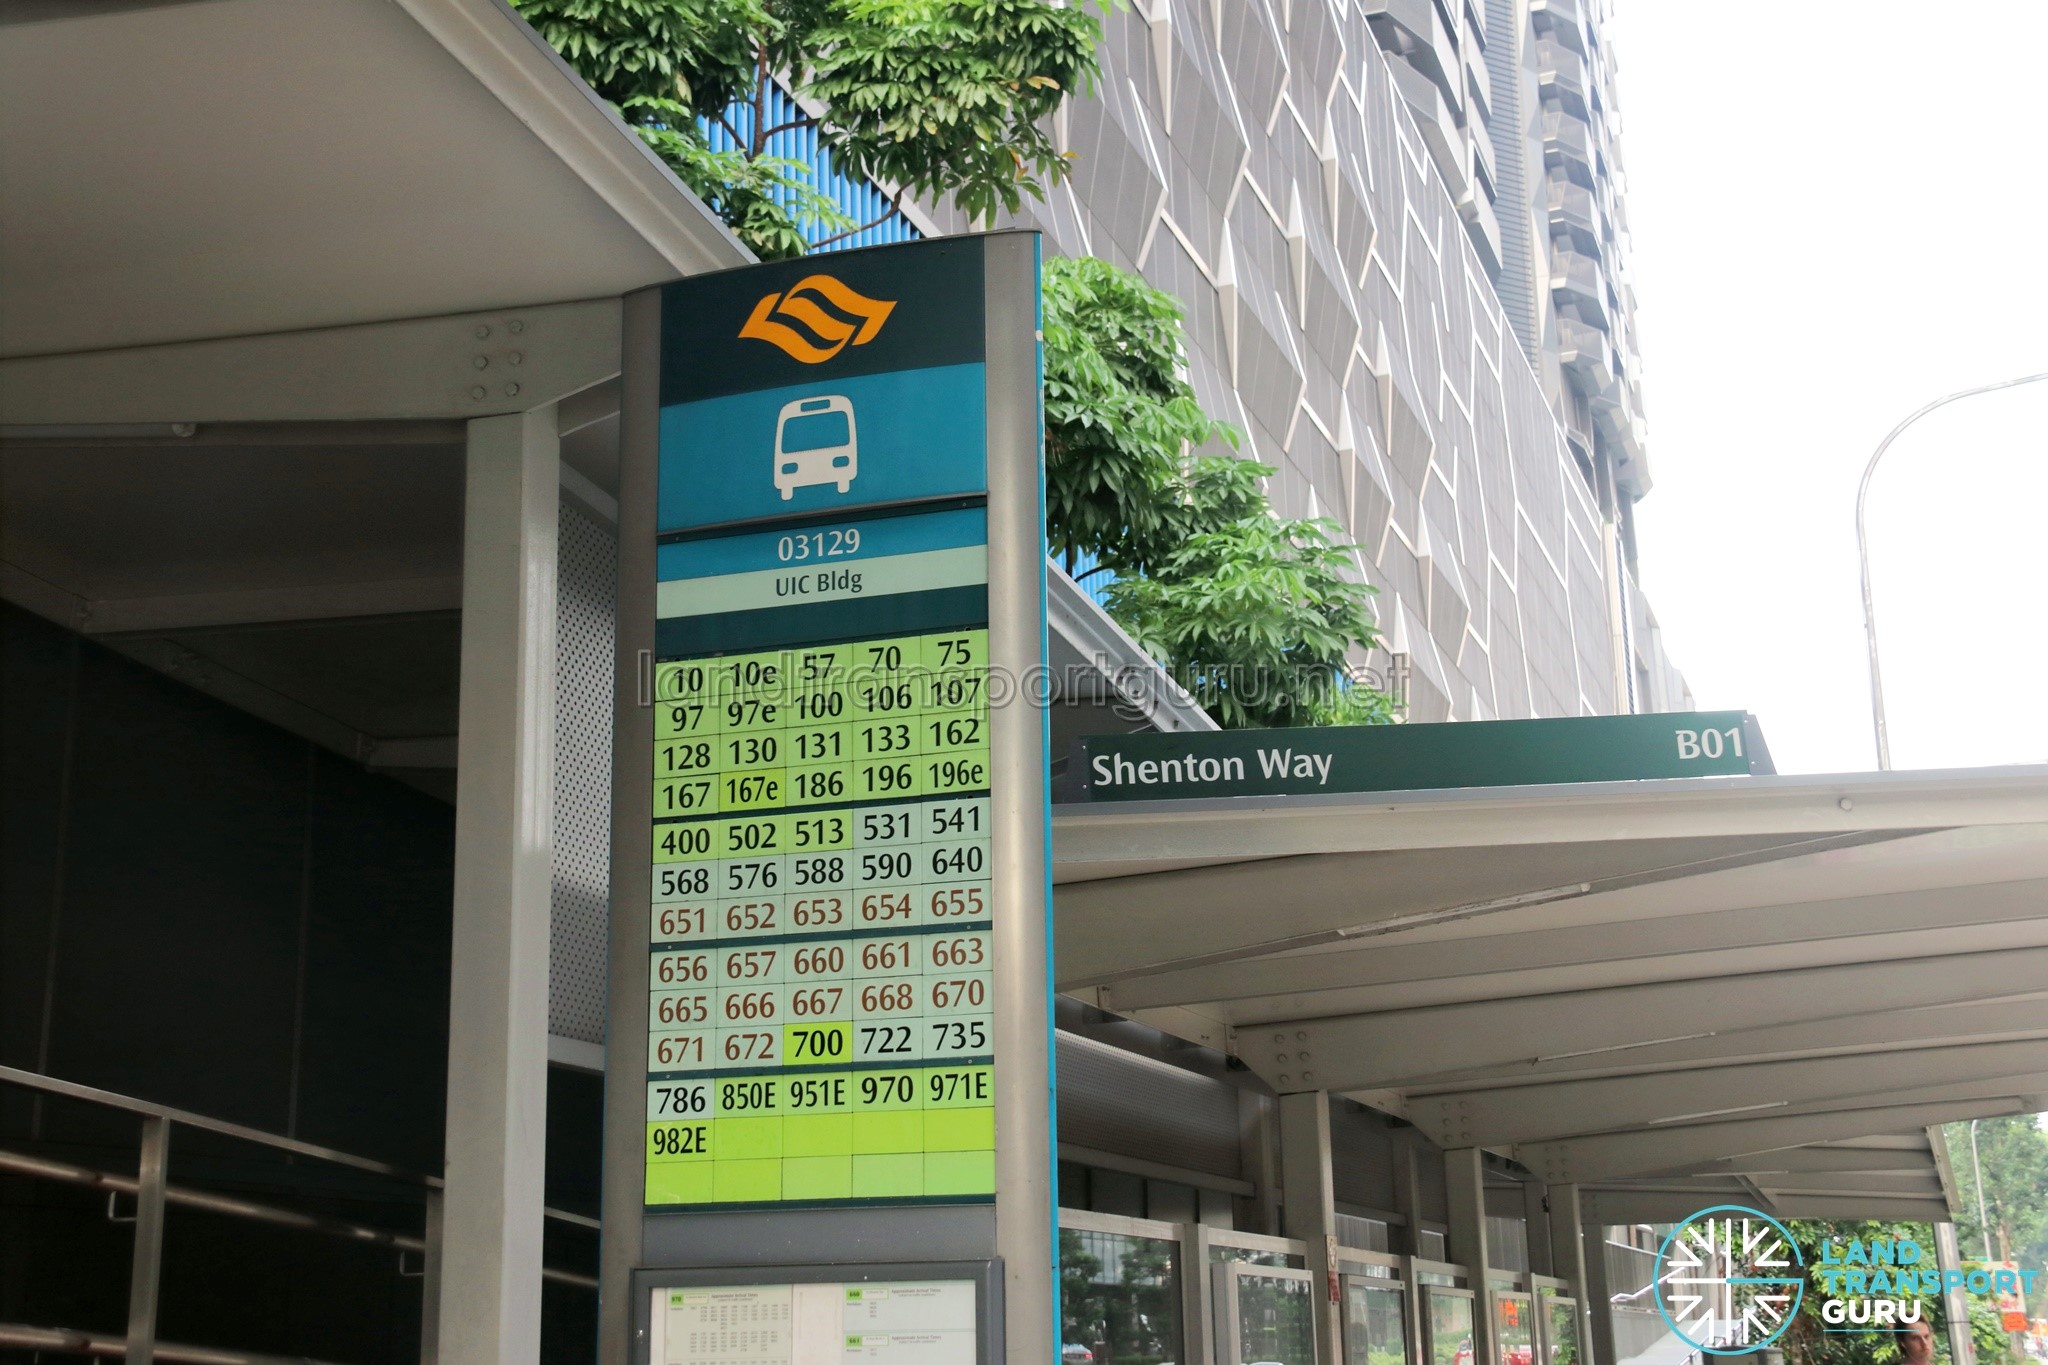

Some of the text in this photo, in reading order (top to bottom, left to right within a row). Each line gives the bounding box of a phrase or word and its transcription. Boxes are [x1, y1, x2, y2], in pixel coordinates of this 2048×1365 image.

[778, 529, 860, 561] 03129
[776, 570, 863, 596] UIC Bldg
[673, 640, 970, 693] 10 10e 57 70 75
[672, 678, 981, 732] 97 97e 100 106 107
[663, 719, 980, 771] 128 130 131 133 162
[1675, 727, 1743, 759] B01
[663, 760, 983, 809] 167 167e 186 196 196e
[1092, 748, 1333, 786] Shenton Way
[661, 807, 980, 855] 400 502 513 531 541
[661, 847, 982, 895] 568 576 588 590 640
[660, 888, 983, 935] 651 652 653 654 655
[659, 938, 983, 982] 656 657 660 661 663
[659, 979, 984, 1023] 665 666 667 668 670
[657, 1022, 985, 1064] 671 672 700 722 735
[656, 1072, 987, 1114] 786 850E 951E 970 971E
[653, 1127, 707, 1155] 982E
